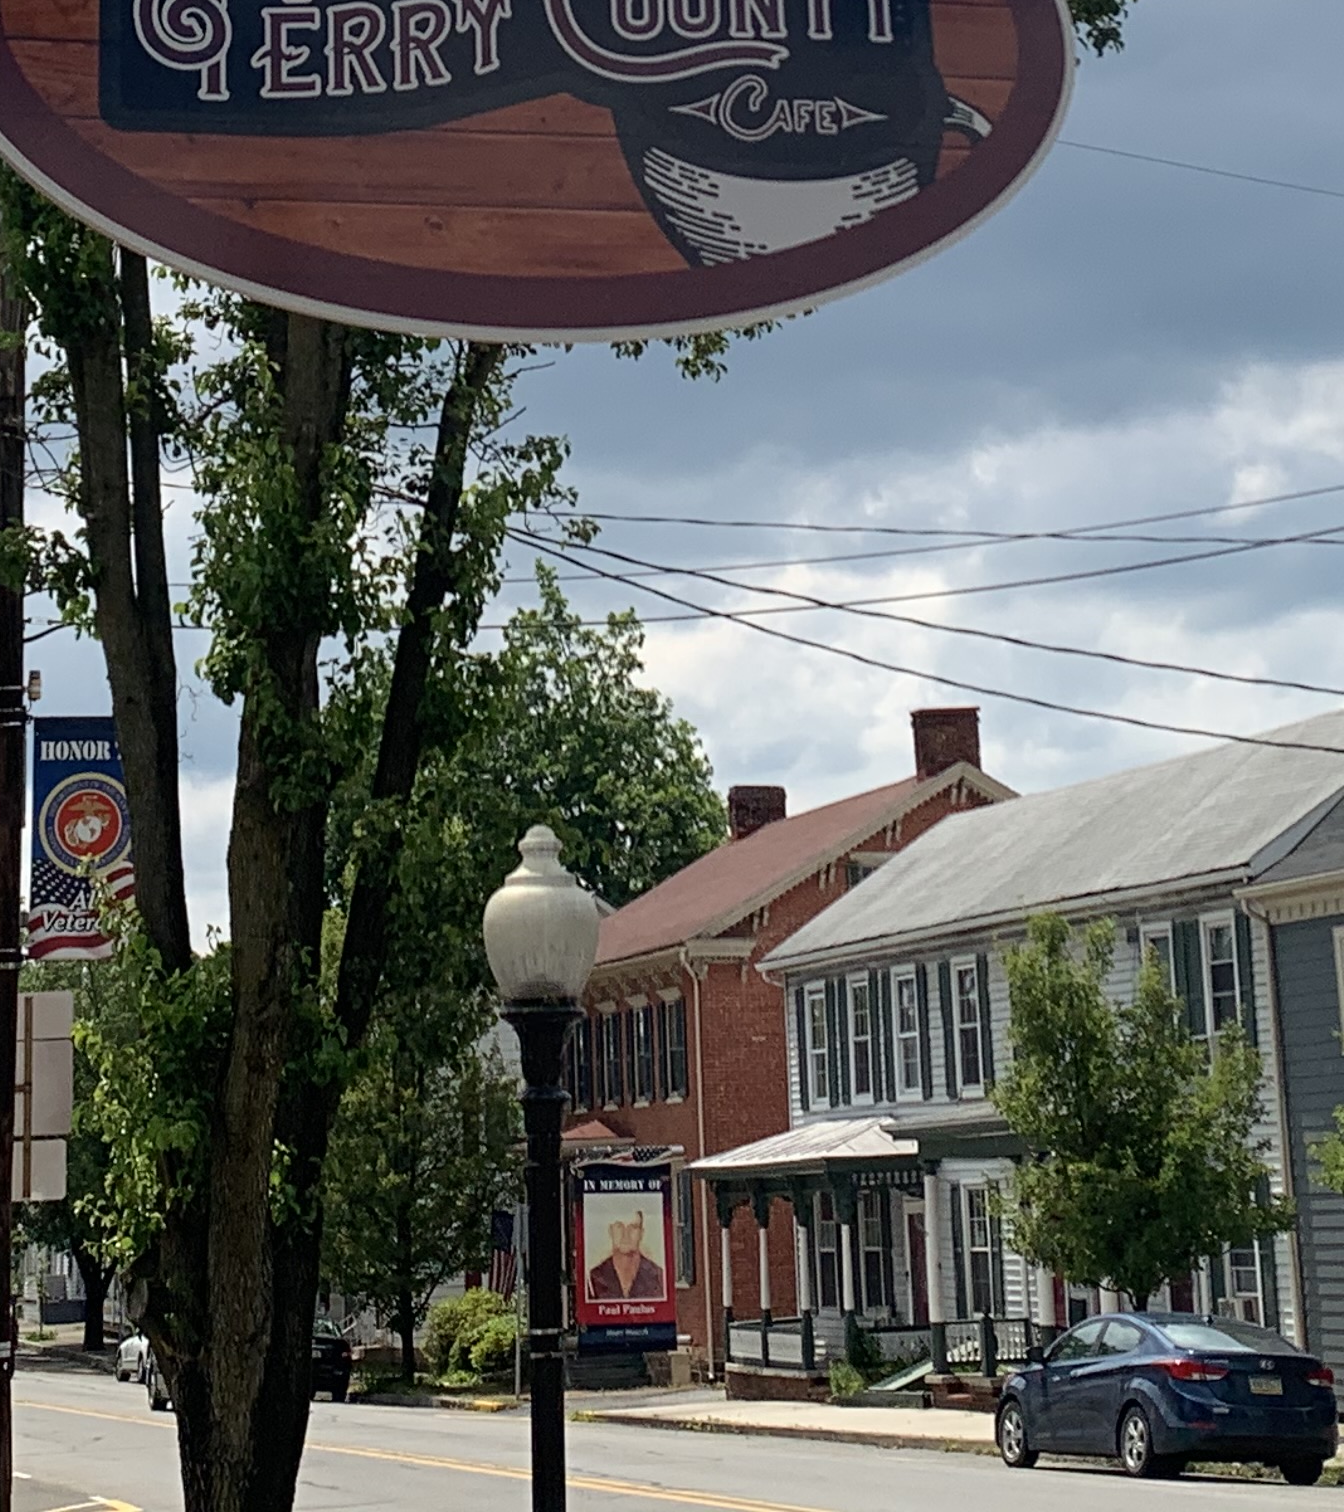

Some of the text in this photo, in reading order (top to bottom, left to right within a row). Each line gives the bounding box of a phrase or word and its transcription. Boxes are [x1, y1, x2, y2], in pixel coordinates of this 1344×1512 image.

[718, 74, 840, 142] CAFE
[40, 740, 111, 761] HONOR
[600, 1179, 645, 1191] MEMORY
